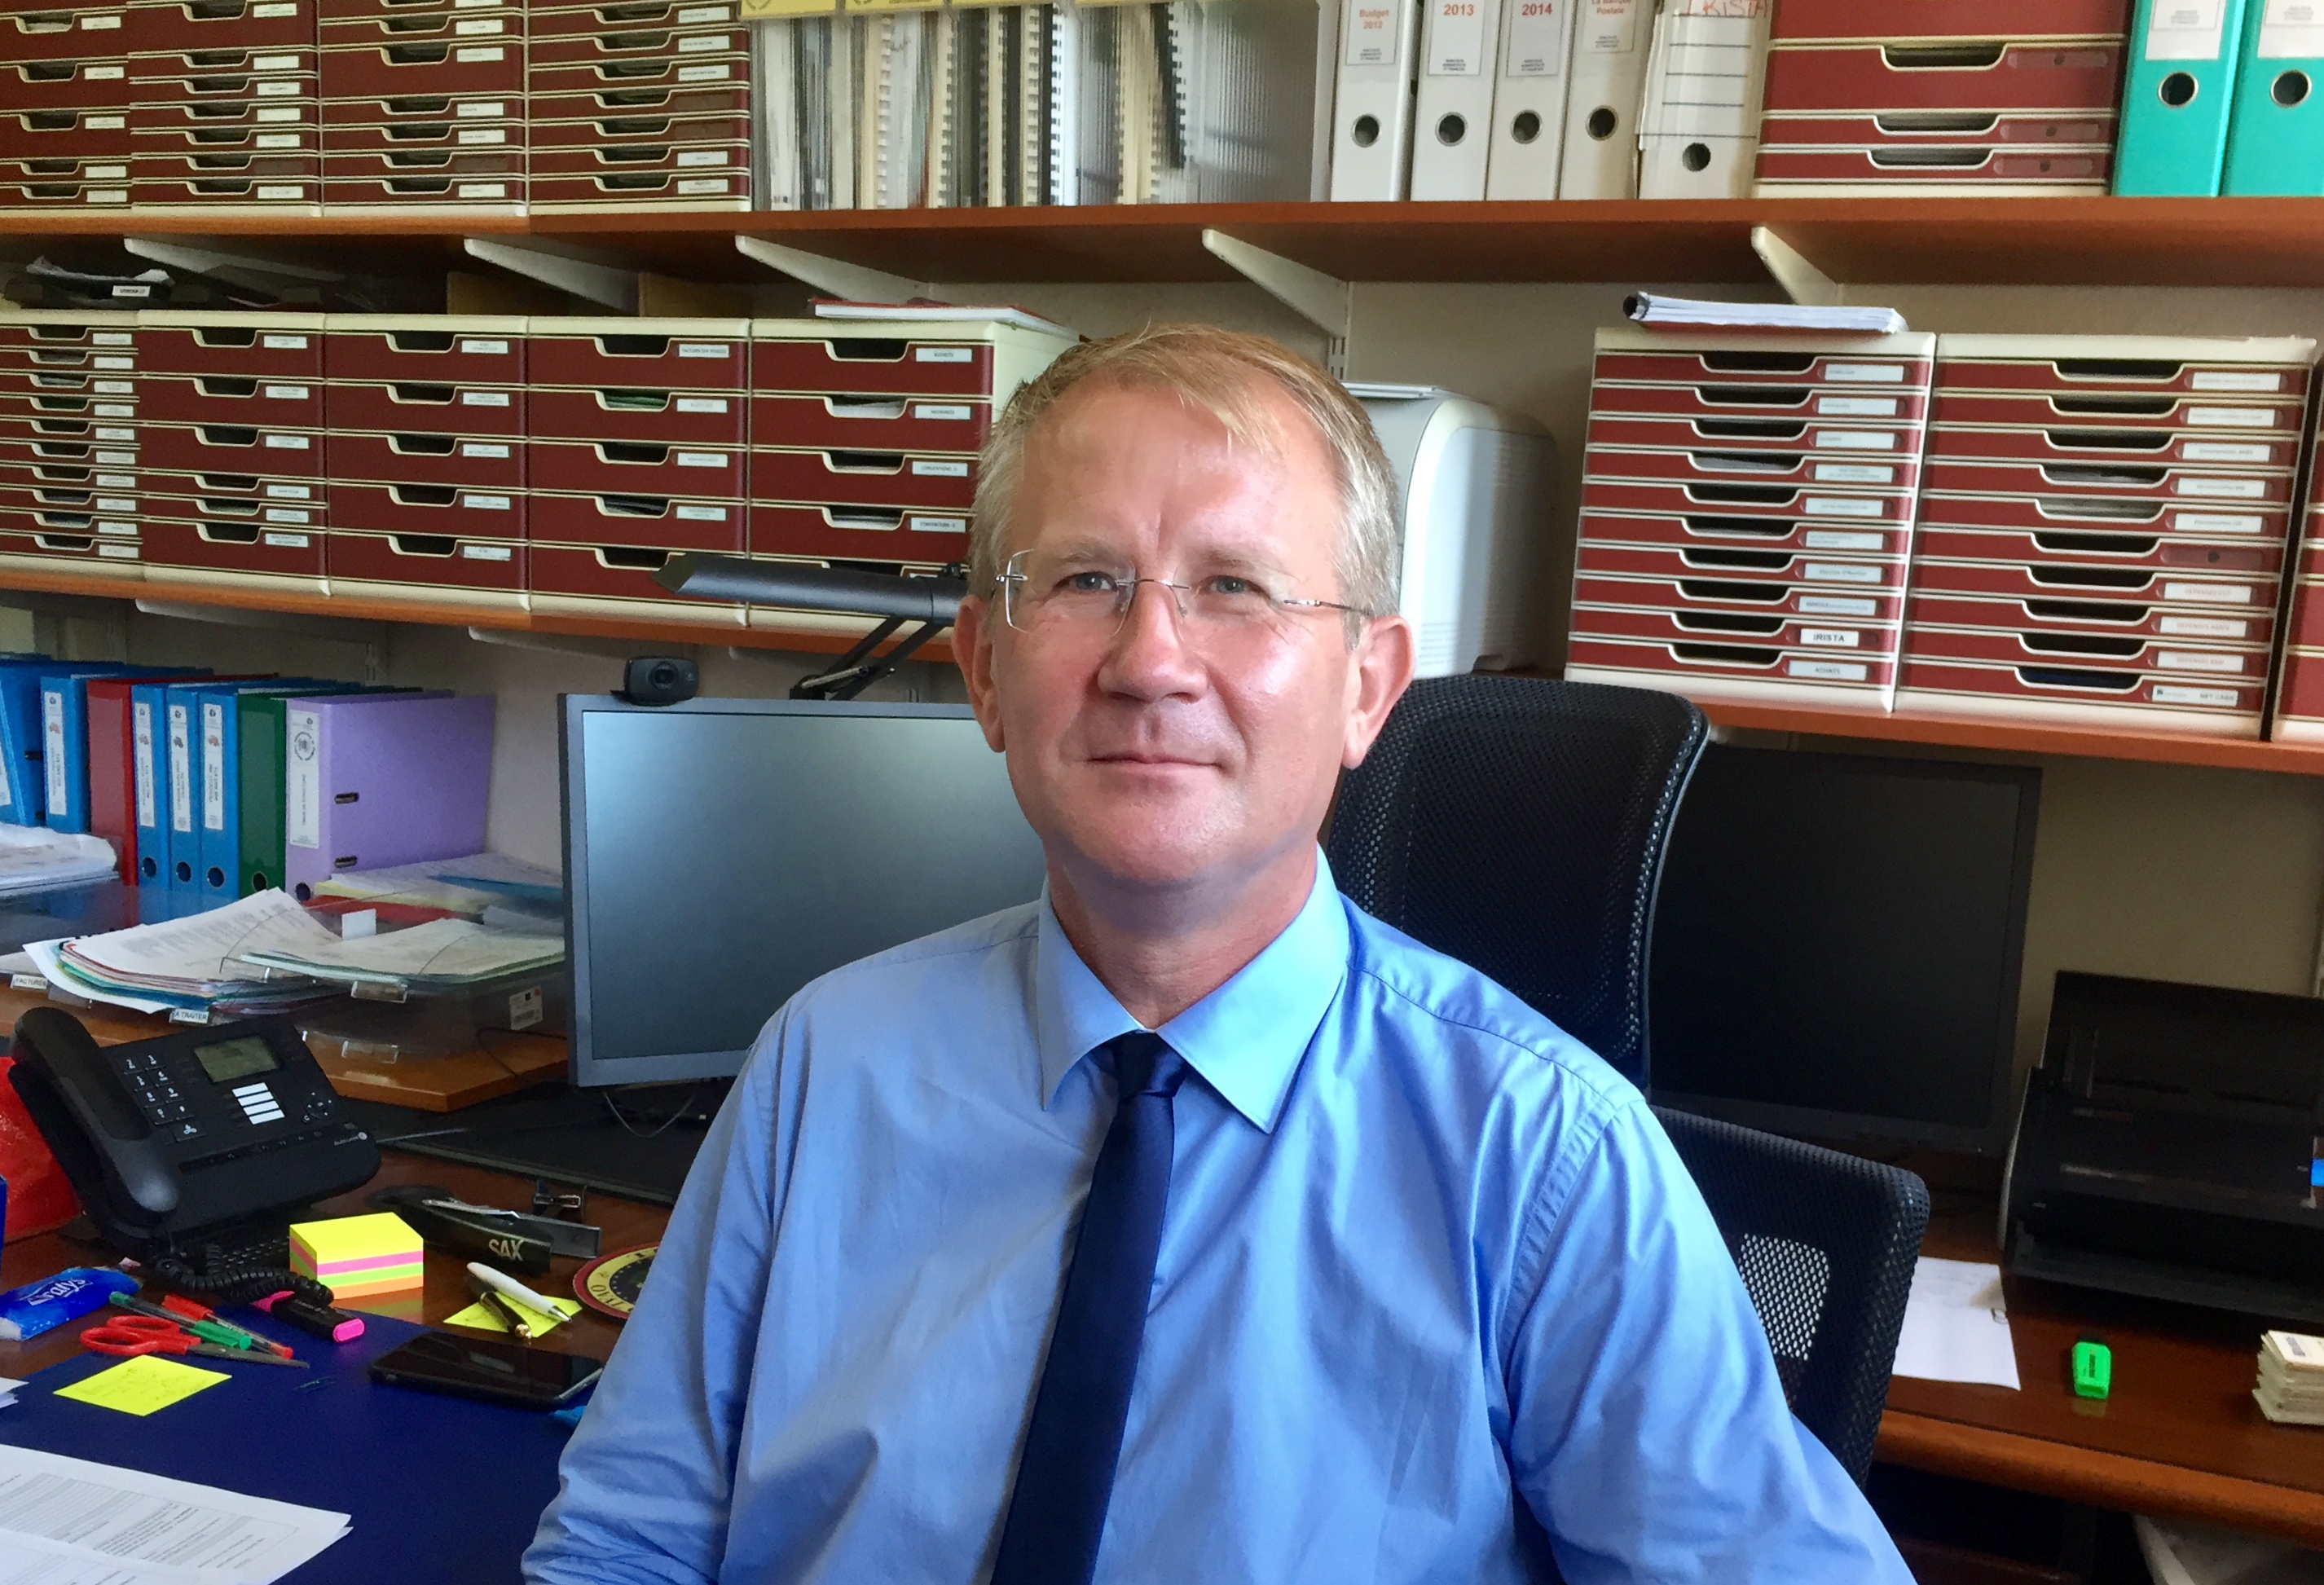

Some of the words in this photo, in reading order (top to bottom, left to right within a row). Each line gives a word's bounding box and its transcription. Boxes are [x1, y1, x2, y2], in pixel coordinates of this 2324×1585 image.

[1359, 9, 1389, 20] Budget
[1443, 3, 1475, 16] 2013
[1521, 3, 1553, 16] 2014
[1813, 634, 1845, 642] IRISTA
[15, 978, 47, 987] FACTURES
[489, 1238, 524, 1261] SAX
